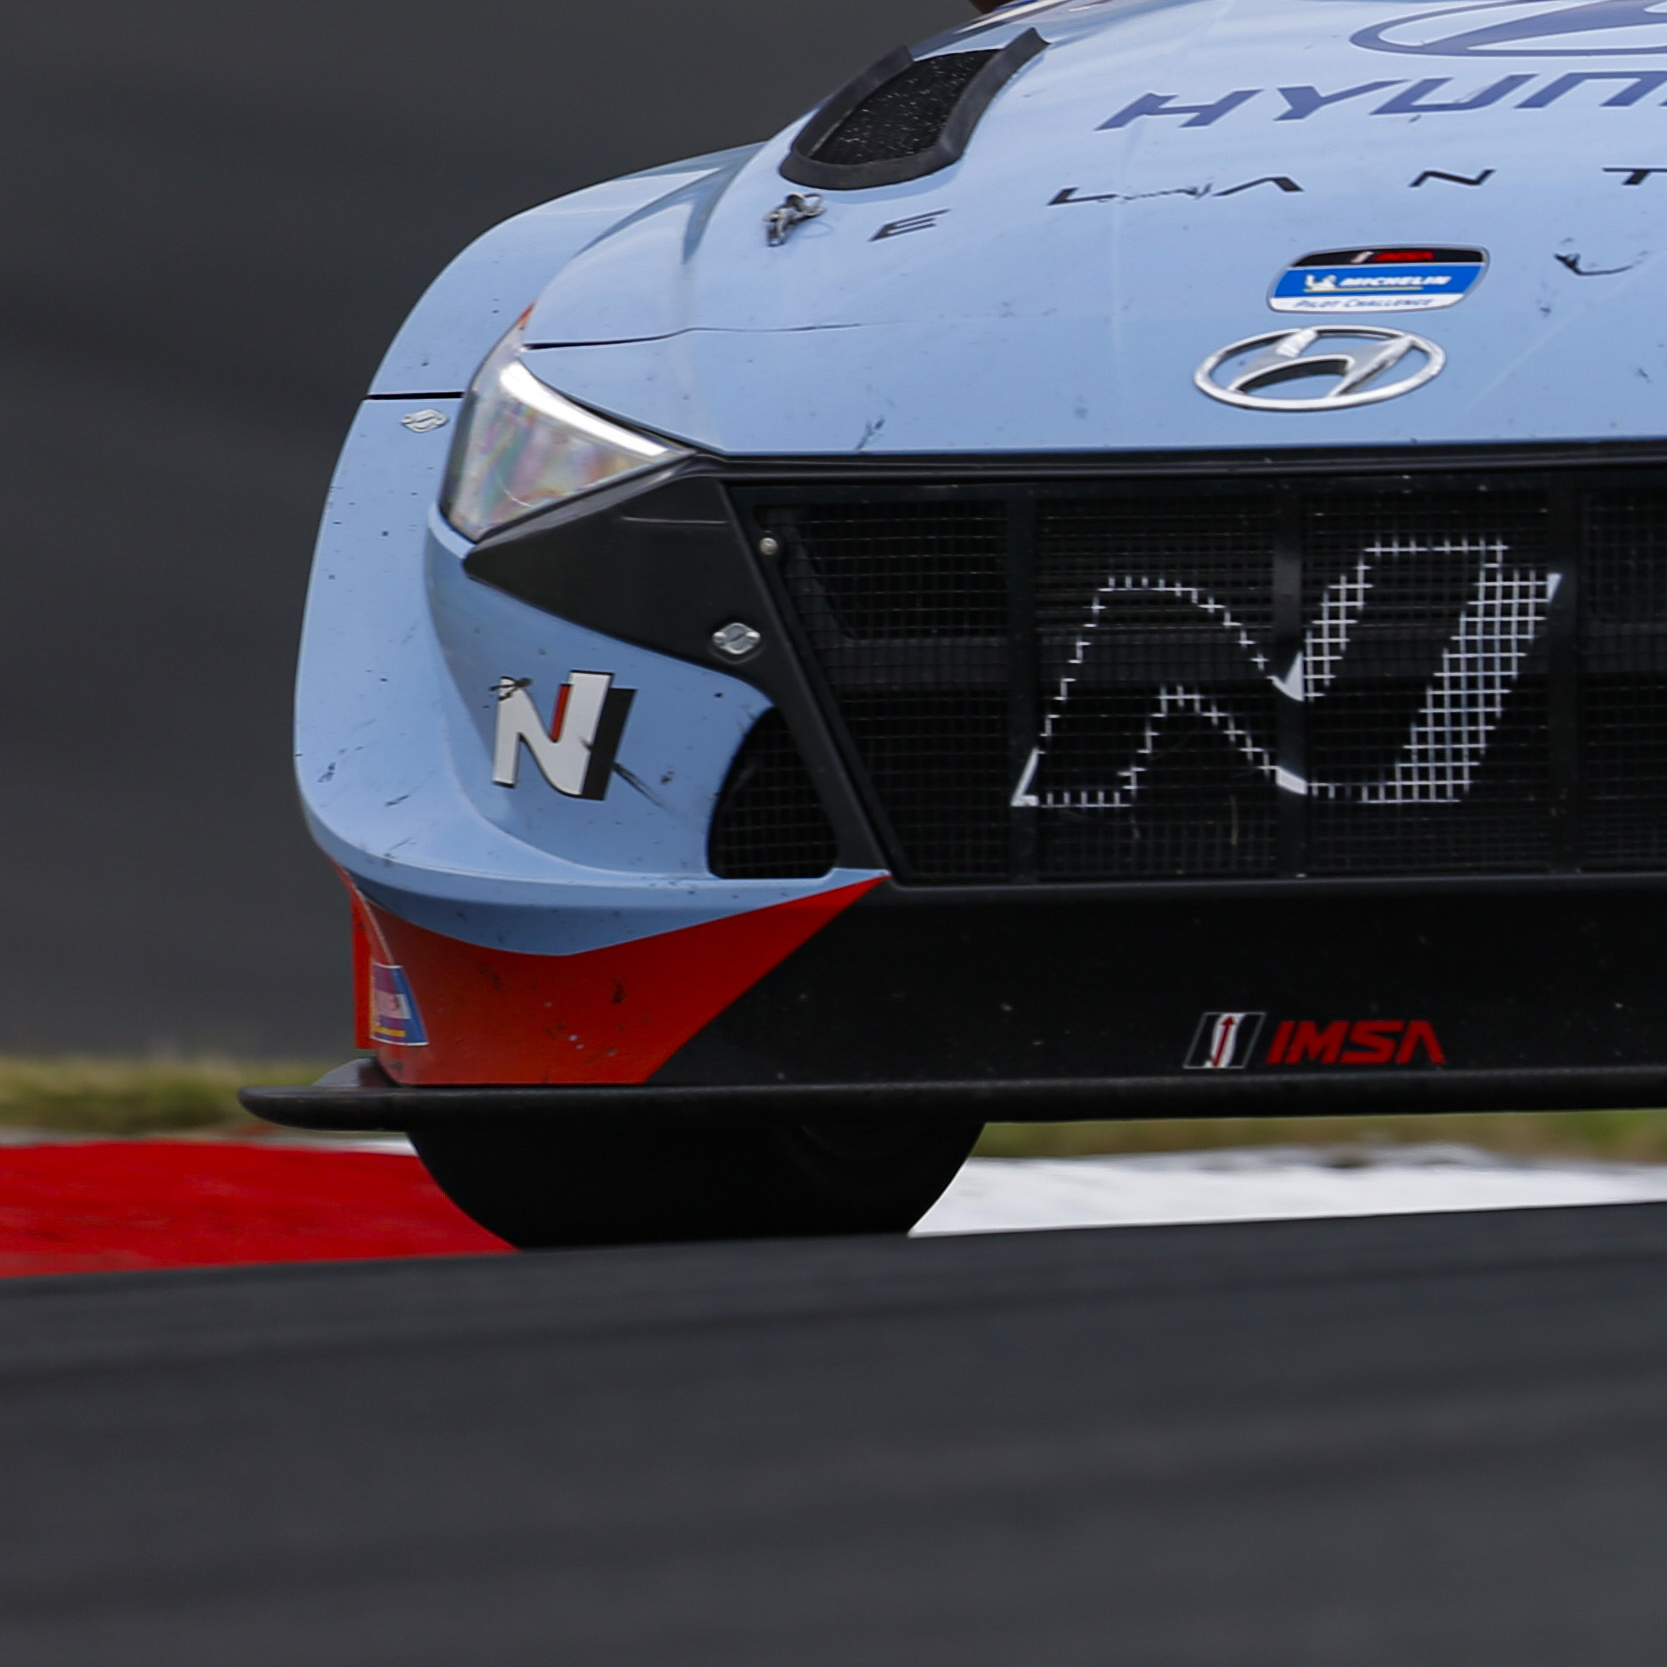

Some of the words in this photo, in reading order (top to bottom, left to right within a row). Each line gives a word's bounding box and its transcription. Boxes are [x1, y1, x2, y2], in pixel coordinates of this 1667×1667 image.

[1340, 276, 1452, 287] MICHELIN
[492, 669, 638, 802] N
[1266, 1019, 1447, 1065] IMSA
